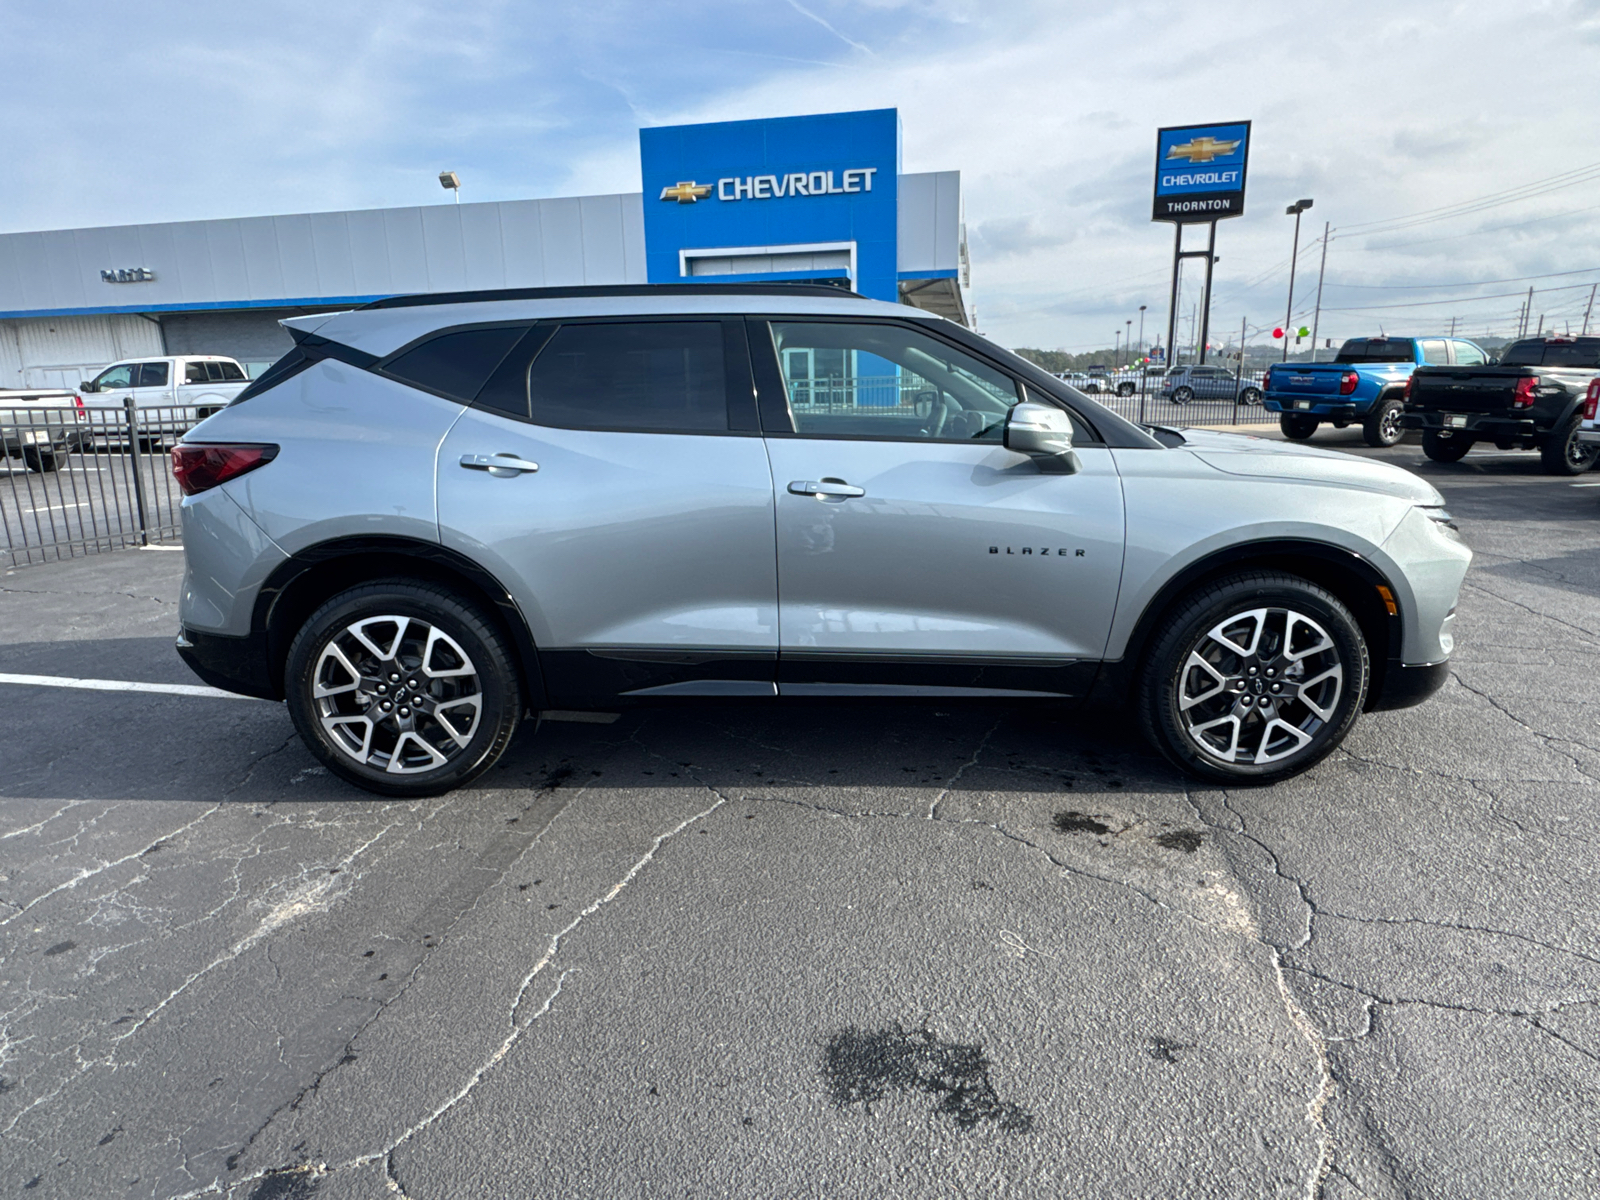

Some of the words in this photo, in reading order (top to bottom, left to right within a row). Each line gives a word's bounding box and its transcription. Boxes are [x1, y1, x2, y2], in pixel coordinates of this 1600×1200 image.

[717, 167, 878, 202] CHEVROLET
[1162, 171, 1239, 187] CHEVROLET
[1167, 199, 1230, 212] THORNTON
[988, 546, 1086, 557] BLAZER
